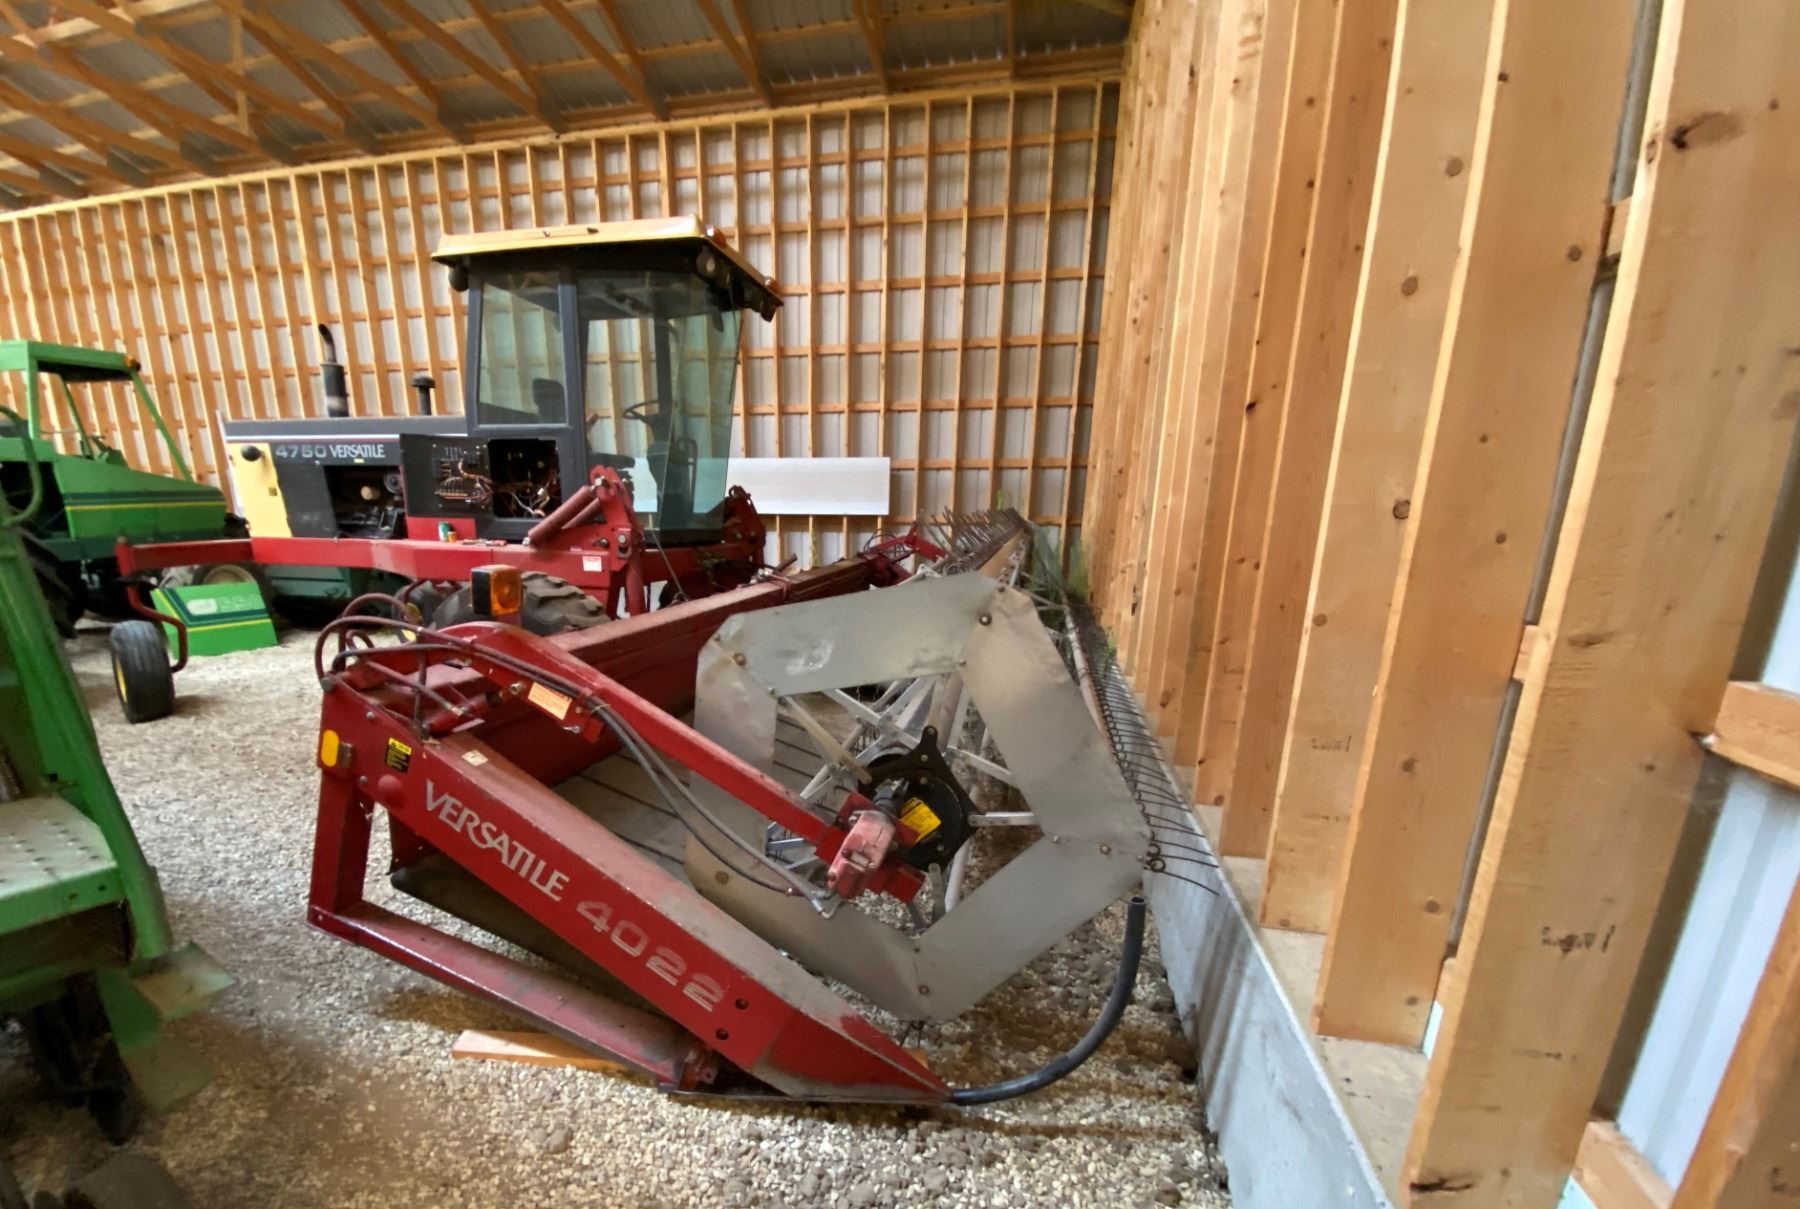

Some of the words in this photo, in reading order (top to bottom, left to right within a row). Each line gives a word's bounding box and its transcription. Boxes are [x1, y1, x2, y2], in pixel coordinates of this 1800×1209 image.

[276, 444, 327, 458] 4750
[329, 443, 386, 458] VERSATILE
[426, 779, 570, 901] VERSATILE
[576, 901, 725, 1012] 4022
